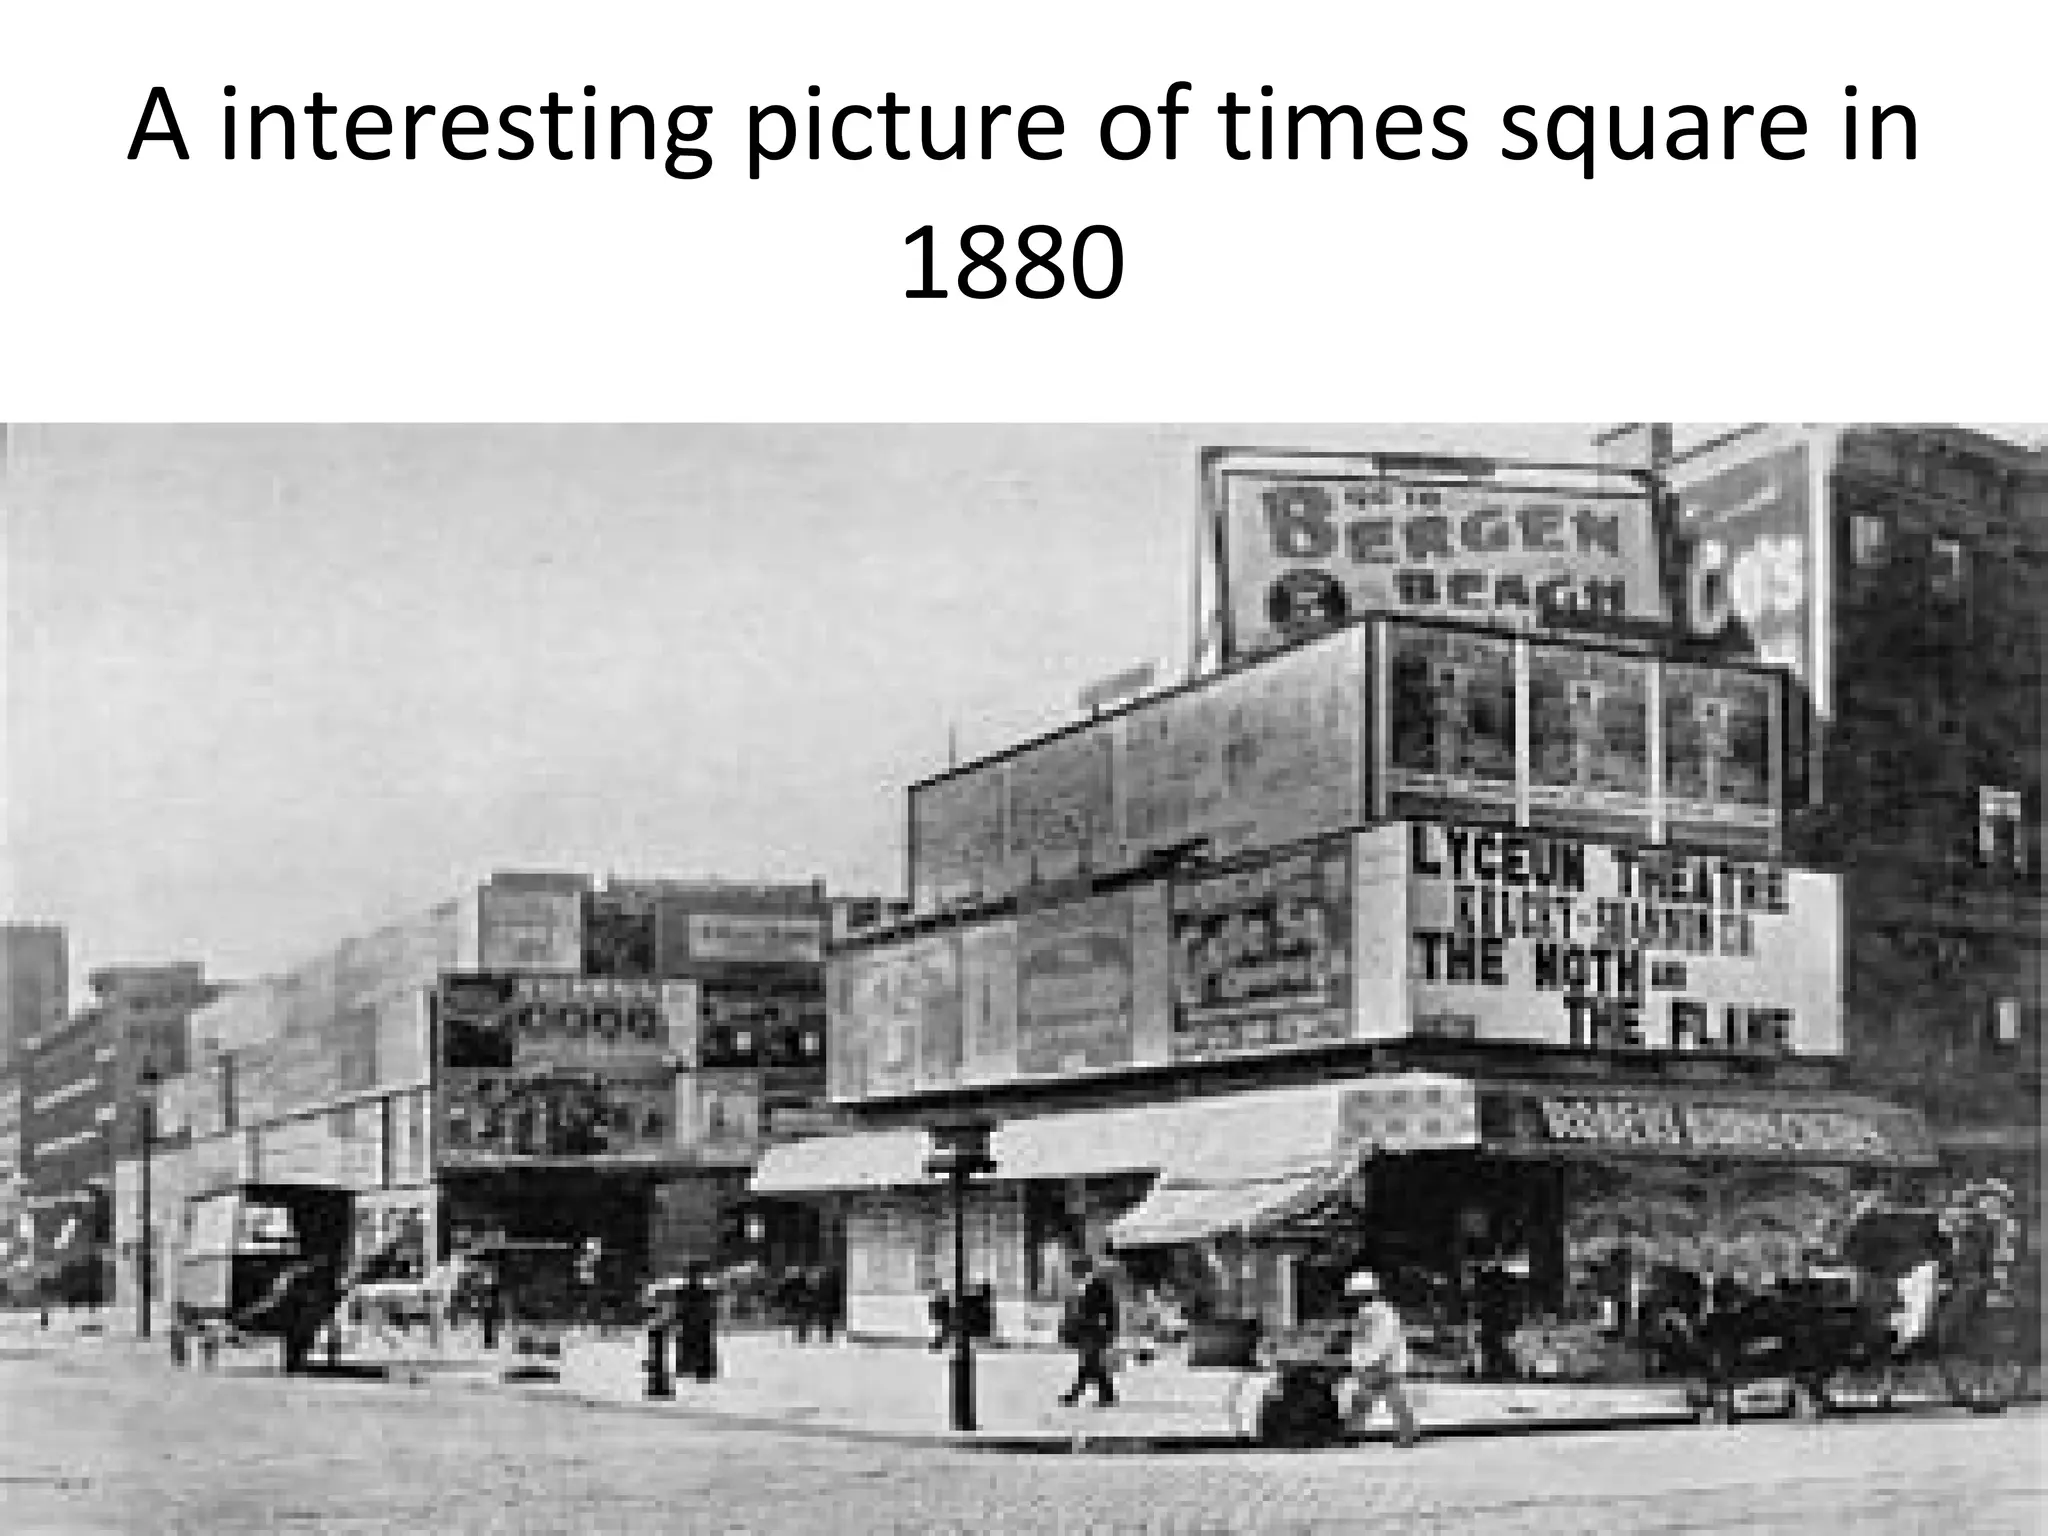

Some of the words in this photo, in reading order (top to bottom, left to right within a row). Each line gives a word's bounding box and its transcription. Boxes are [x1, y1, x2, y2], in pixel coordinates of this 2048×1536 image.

[1262, 486, 1620, 565] BERGEN
[1413, 932, 1507, 986] THE
[1565, 997, 1646, 1047] THE
